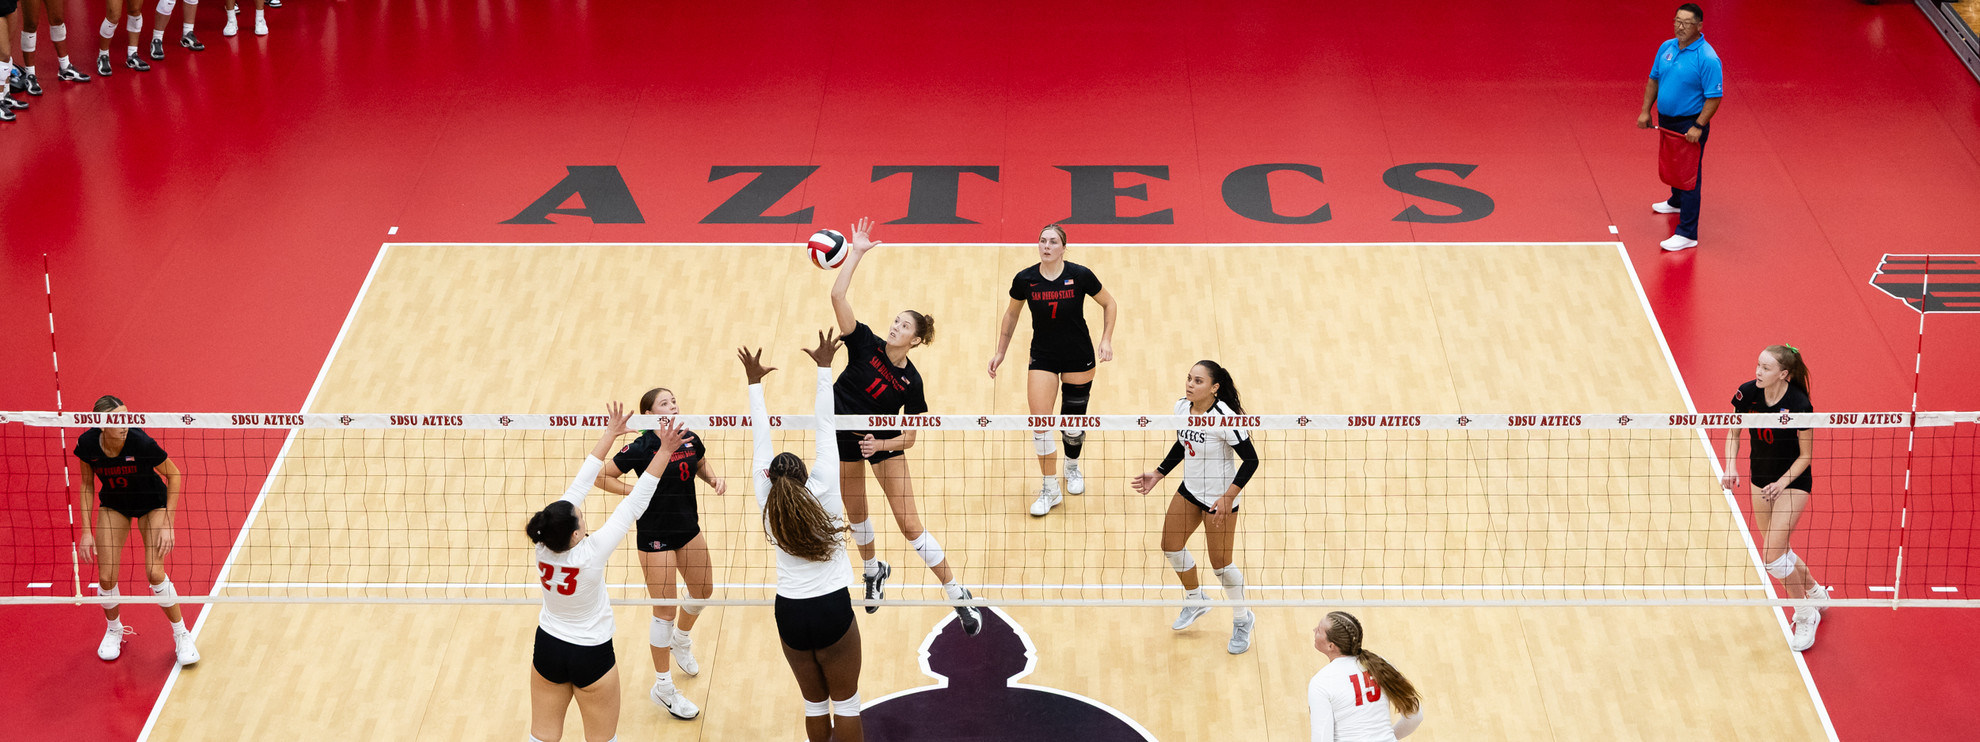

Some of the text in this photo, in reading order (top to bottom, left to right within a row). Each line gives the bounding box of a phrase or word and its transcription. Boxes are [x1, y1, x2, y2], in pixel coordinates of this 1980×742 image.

[497, 163, 1495, 225] AZTECS
[1031, 289, 1075, 301] SAN DIEGO STATE
[1048, 301, 1058, 319] 7
[865, 377, 888, 399] 11
[74, 414, 146, 425] SDSU AZTECS
[232, 414, 305, 426] SDSU AZTECS
[390, 415, 464, 426] SDSU AZTECS
[550, 415, 609, 427] SDSU AZTE
[709, 415, 737, 427] SDSU
[868, 416, 942, 427] SDSU AZTECS
[1028, 416, 1101, 427] SDSU AZTECS
[1188, 416, 1261, 427] SDSU AZTECS
[1348, 416, 1421, 427] SDSU AZTECS
[1508, 415, 1582, 426] SDSU AZTECS
[1669, 414, 1743, 426] SDSU AZTECS
[1829, 413, 1903, 425] SDSU AZTECS
[679, 461, 690, 481] 8
[108, 476, 128, 489] 19
[538, 560, 580, 596] 23
[1349, 670, 1381, 707] 15
